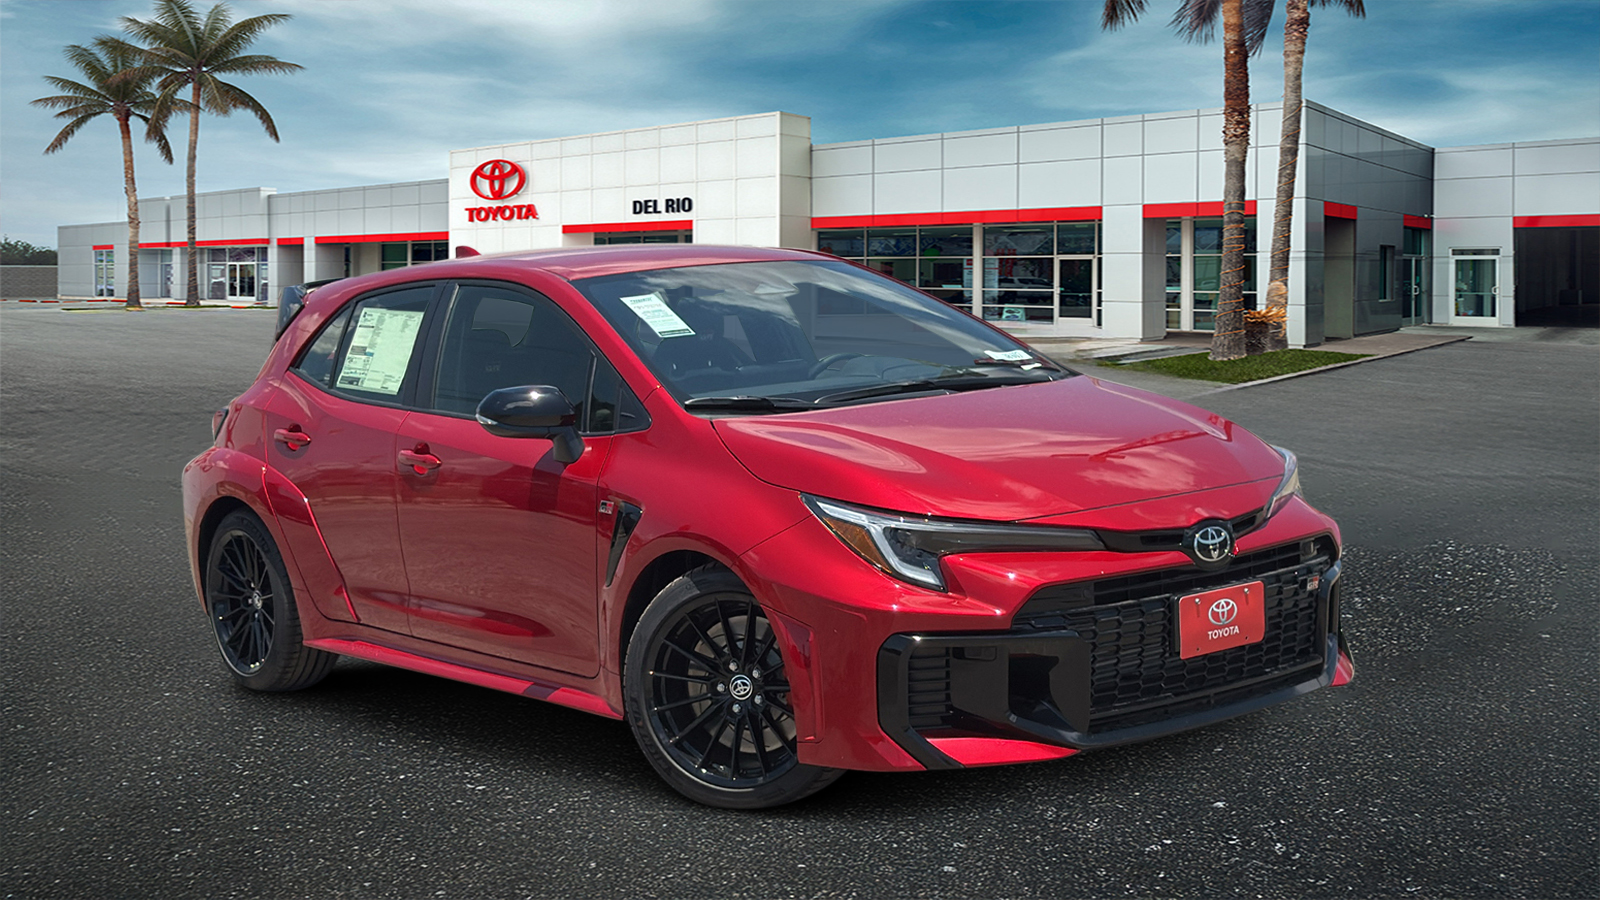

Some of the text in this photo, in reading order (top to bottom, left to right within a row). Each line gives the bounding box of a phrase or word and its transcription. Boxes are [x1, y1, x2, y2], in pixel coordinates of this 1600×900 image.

[464, 204, 539, 222] TOYOTA
[632, 197, 693, 215] DEL RIO
[1207, 625, 1240, 640] TOYOTA
